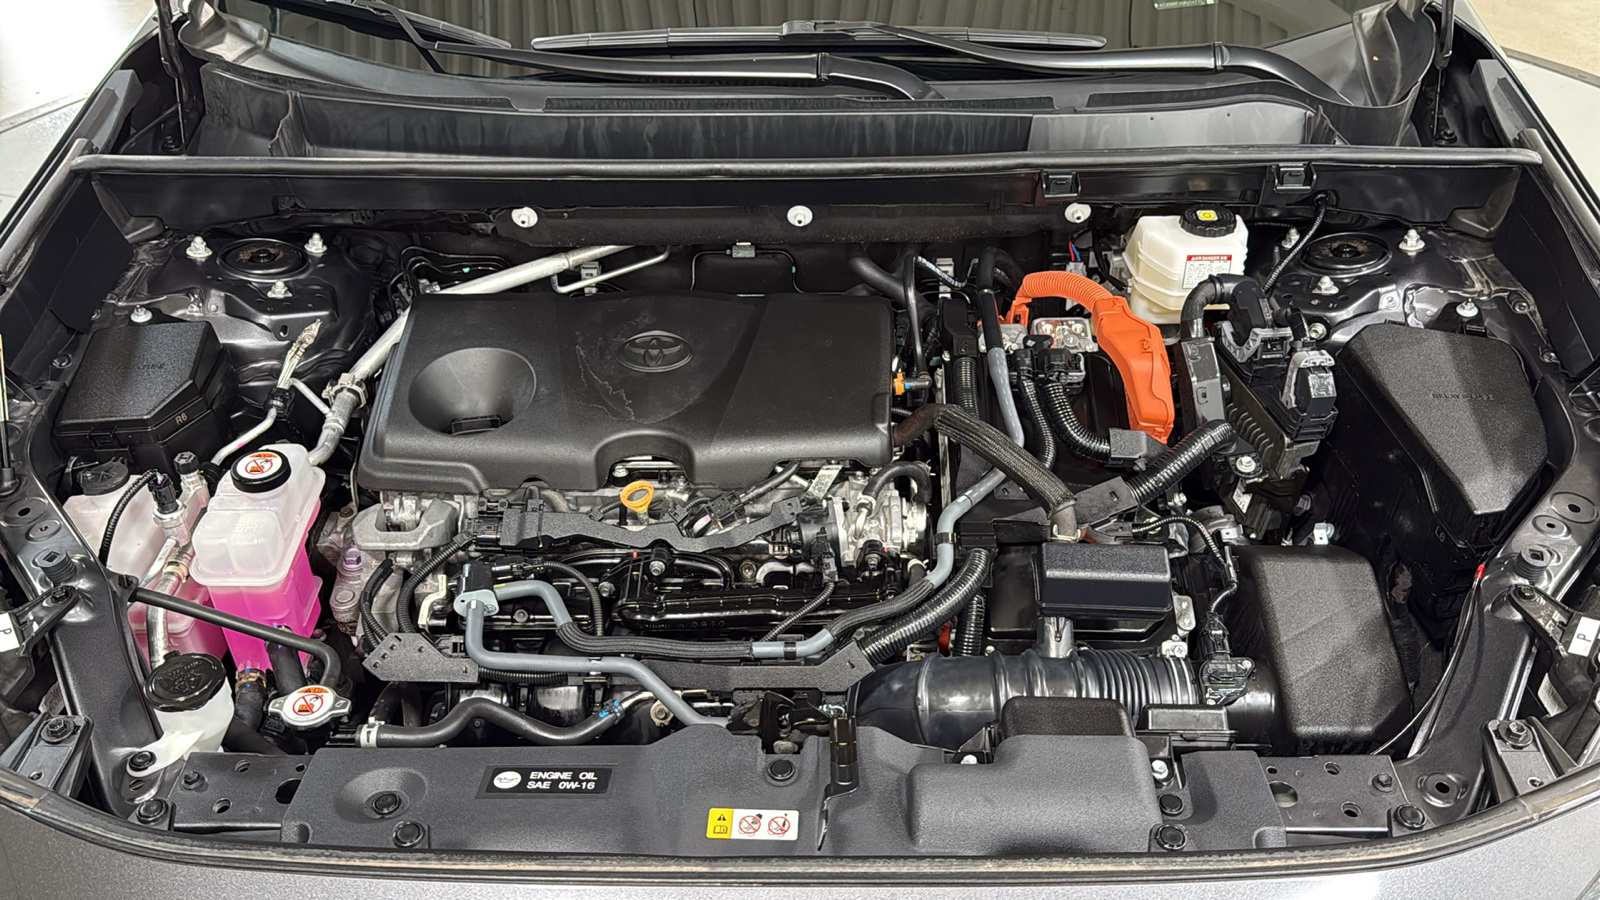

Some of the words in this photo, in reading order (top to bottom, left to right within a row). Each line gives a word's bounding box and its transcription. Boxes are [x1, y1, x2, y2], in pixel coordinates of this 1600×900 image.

[175, 412, 188, 426] R6
[1576, 633, 1592, 643] P
[529, 771, 573, 780] ENGINE
[578, 771, 598, 780] OIL
[526, 781, 552, 789] SAE
[558, 781, 596, 790] 0W-16
